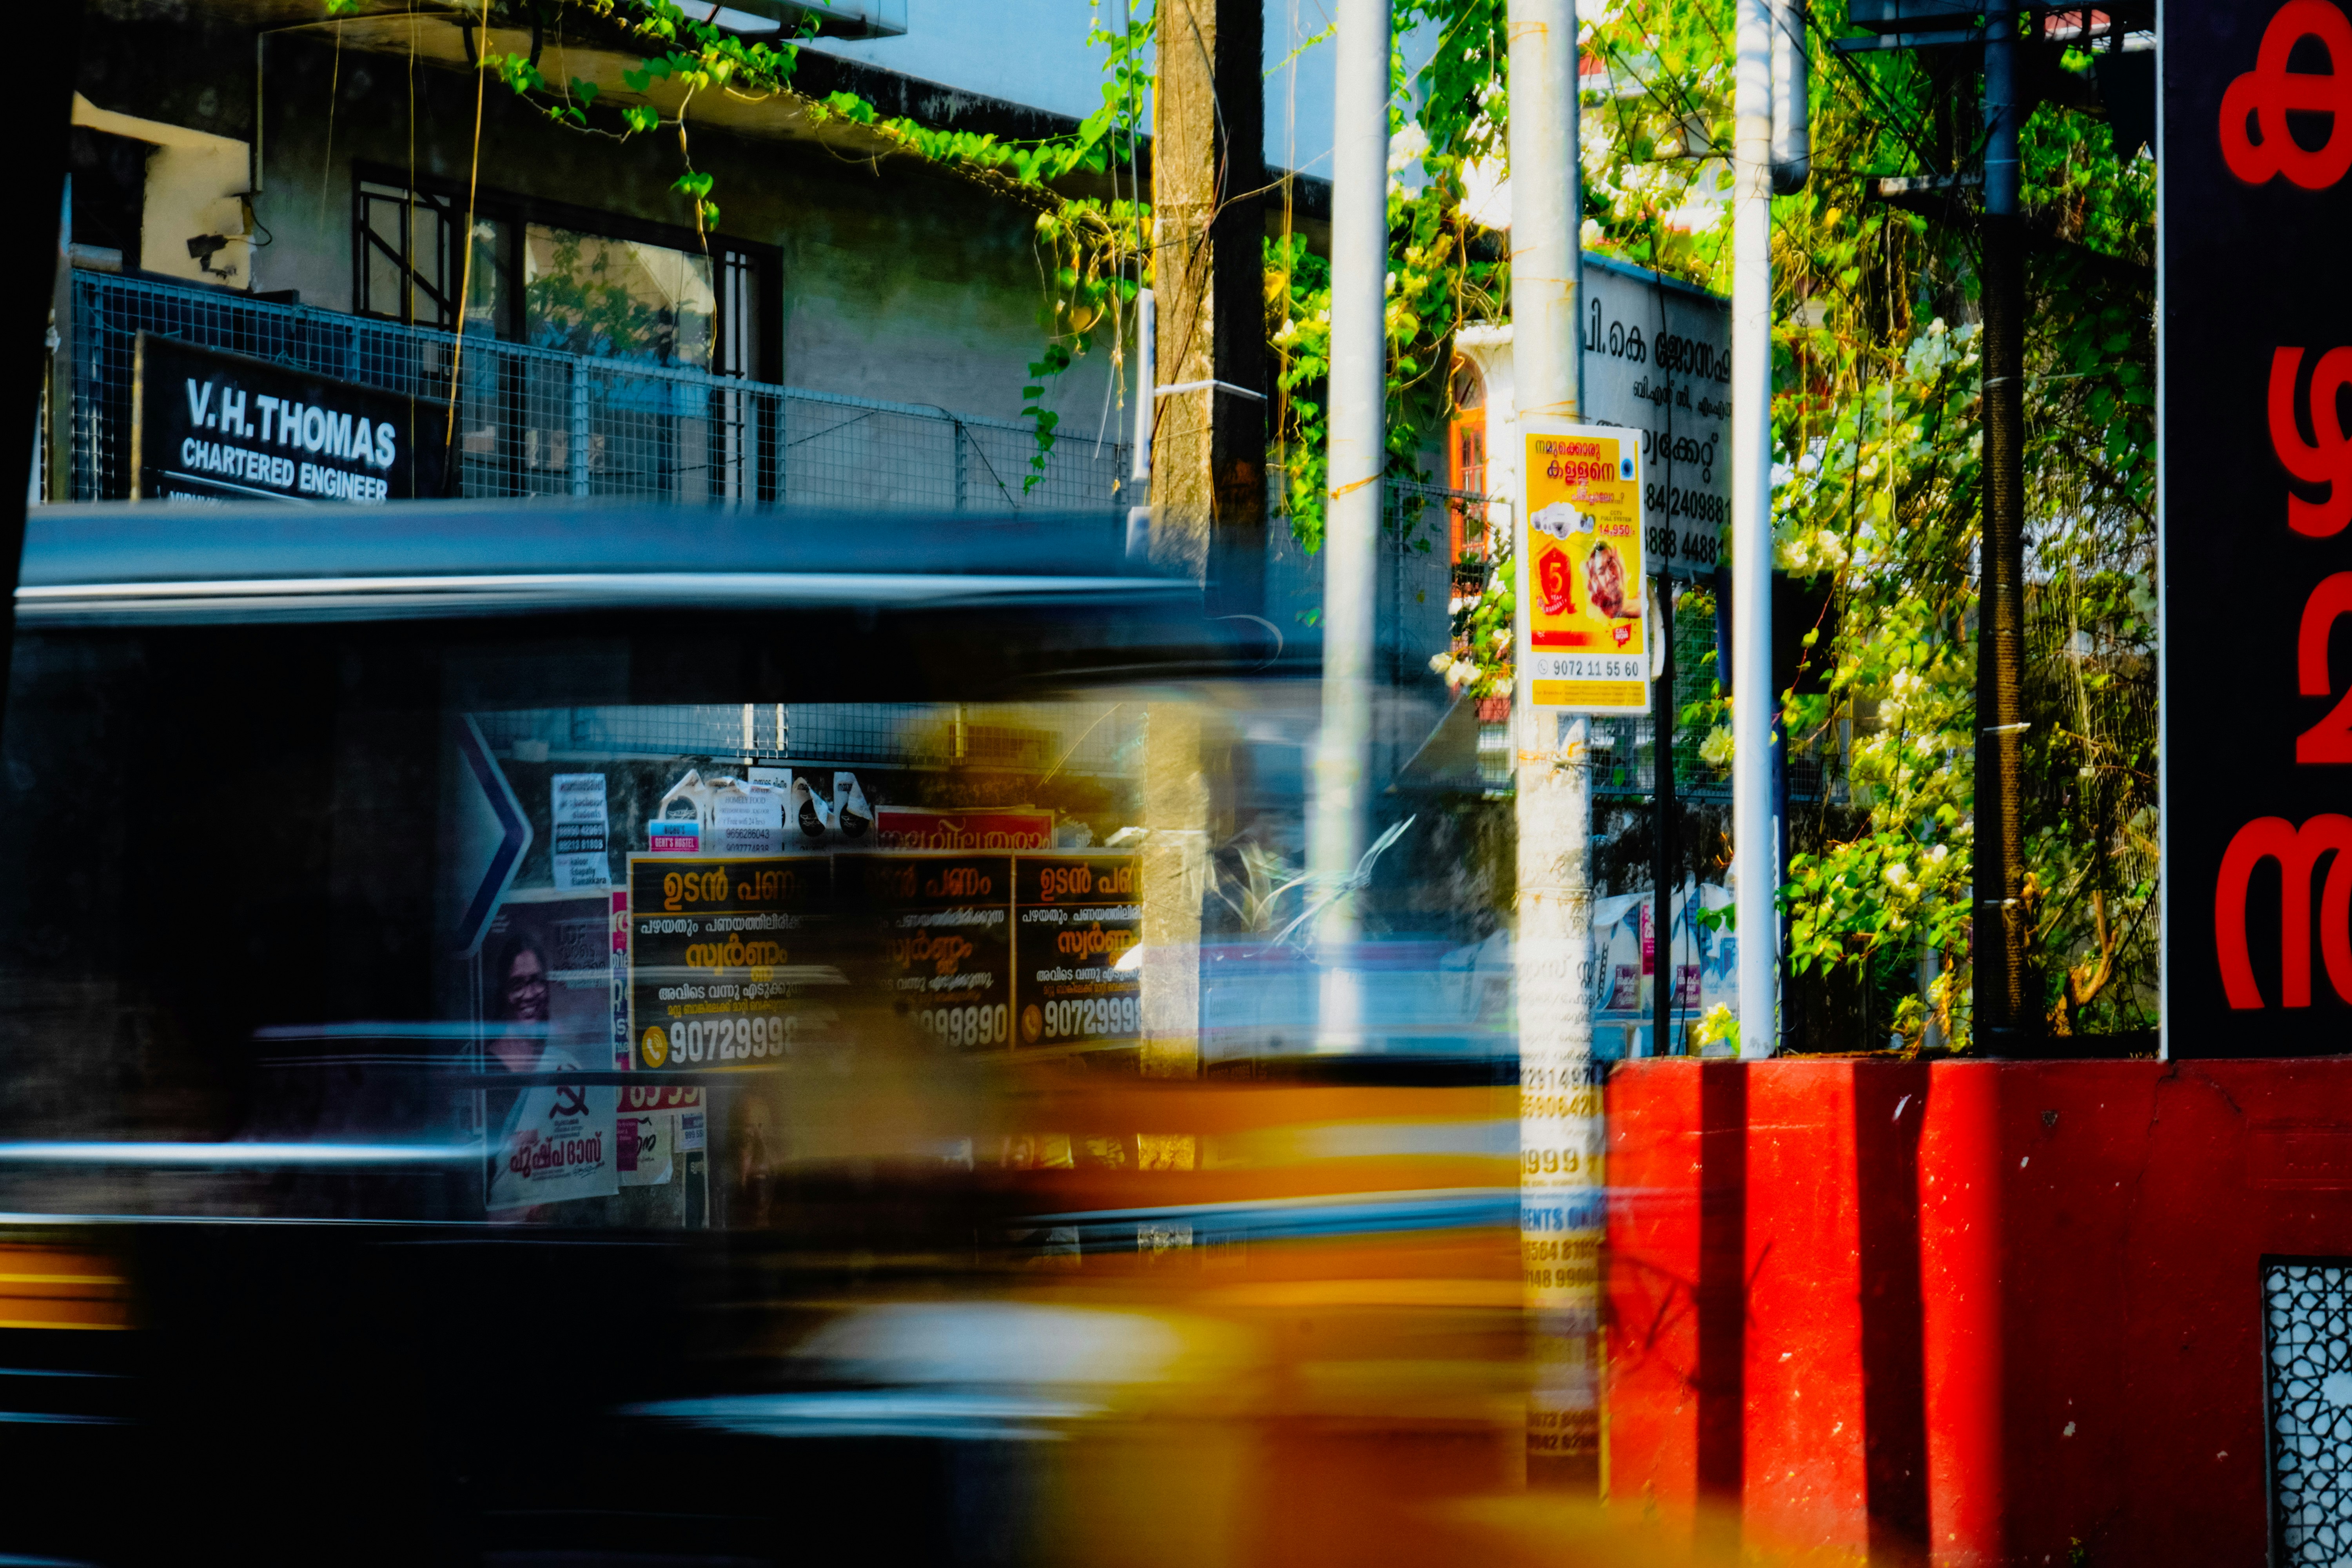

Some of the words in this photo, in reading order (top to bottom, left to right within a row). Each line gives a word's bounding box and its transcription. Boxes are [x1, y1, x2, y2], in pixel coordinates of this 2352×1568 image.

[186, 377, 396, 470] V.H.THOMAS
[180, 437, 295, 488] CHARTERED
[298, 462, 388, 504] ENGINEER
[1644, 483, 1666, 513] 84
[1645, 526, 1677, 558] 888
[1549, 562, 1563, 593] 5
[1553, 660, 1583, 676] 9072
[1588, 661, 1602, 676] 11
[1607, 661, 1621, 676] 55
[1624, 661, 1639, 677] 60
[655, 837, 673, 848] GENT'S
[674, 837, 695, 848] HOSTEL
[726, 828, 770, 839] 9656286043
[1073, 904, 1142, 922] പണയത്തിലിരി
